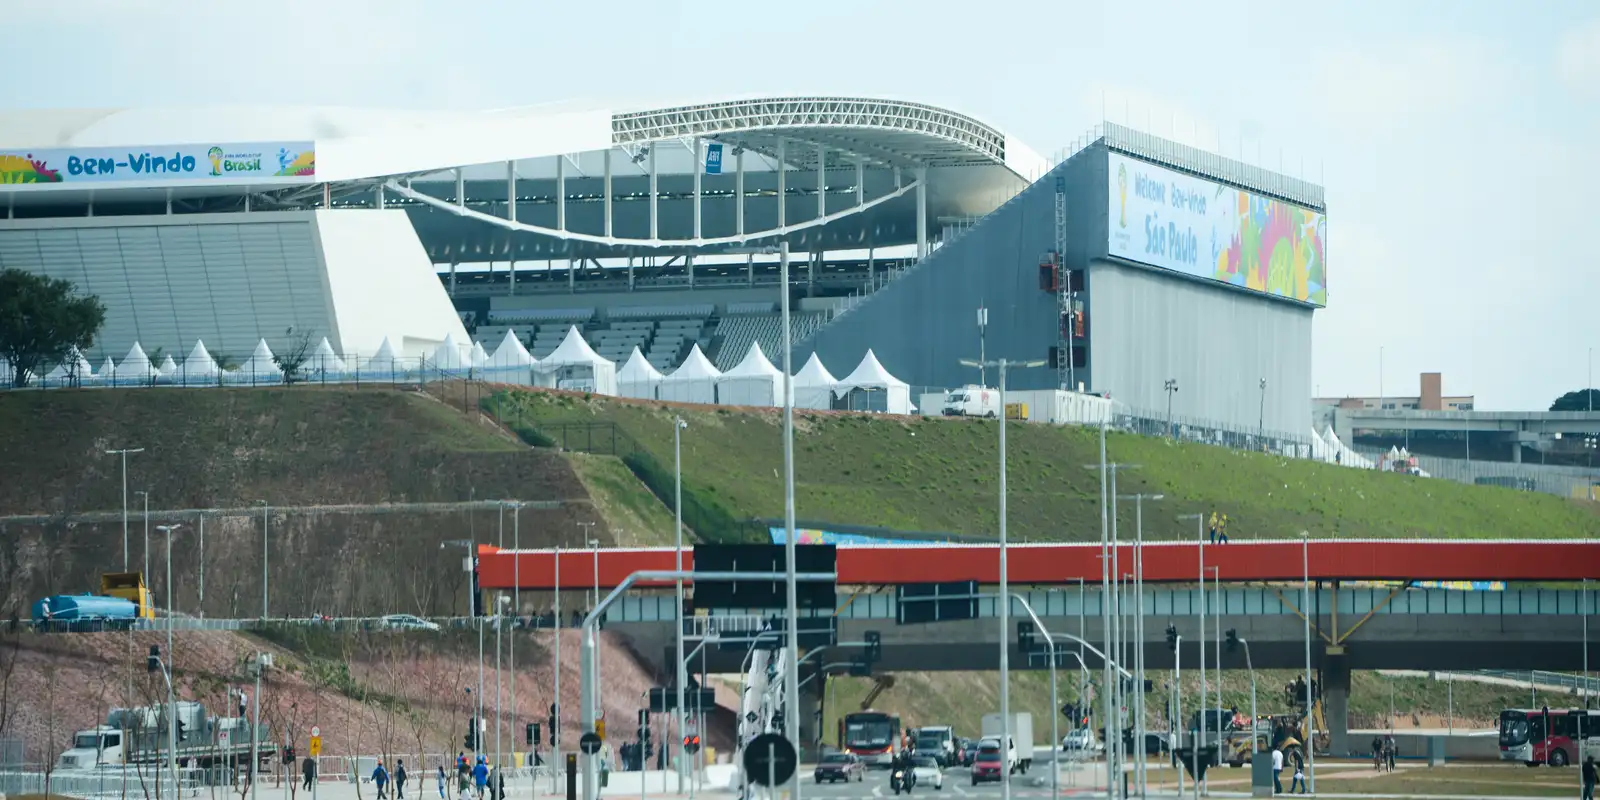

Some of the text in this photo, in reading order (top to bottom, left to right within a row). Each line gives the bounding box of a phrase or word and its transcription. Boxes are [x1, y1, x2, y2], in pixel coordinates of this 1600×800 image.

[224, 159, 261, 172] Brasil
[1134, 171, 1165, 204] Welcome
[1145, 210, 1197, 267] São Paulo
